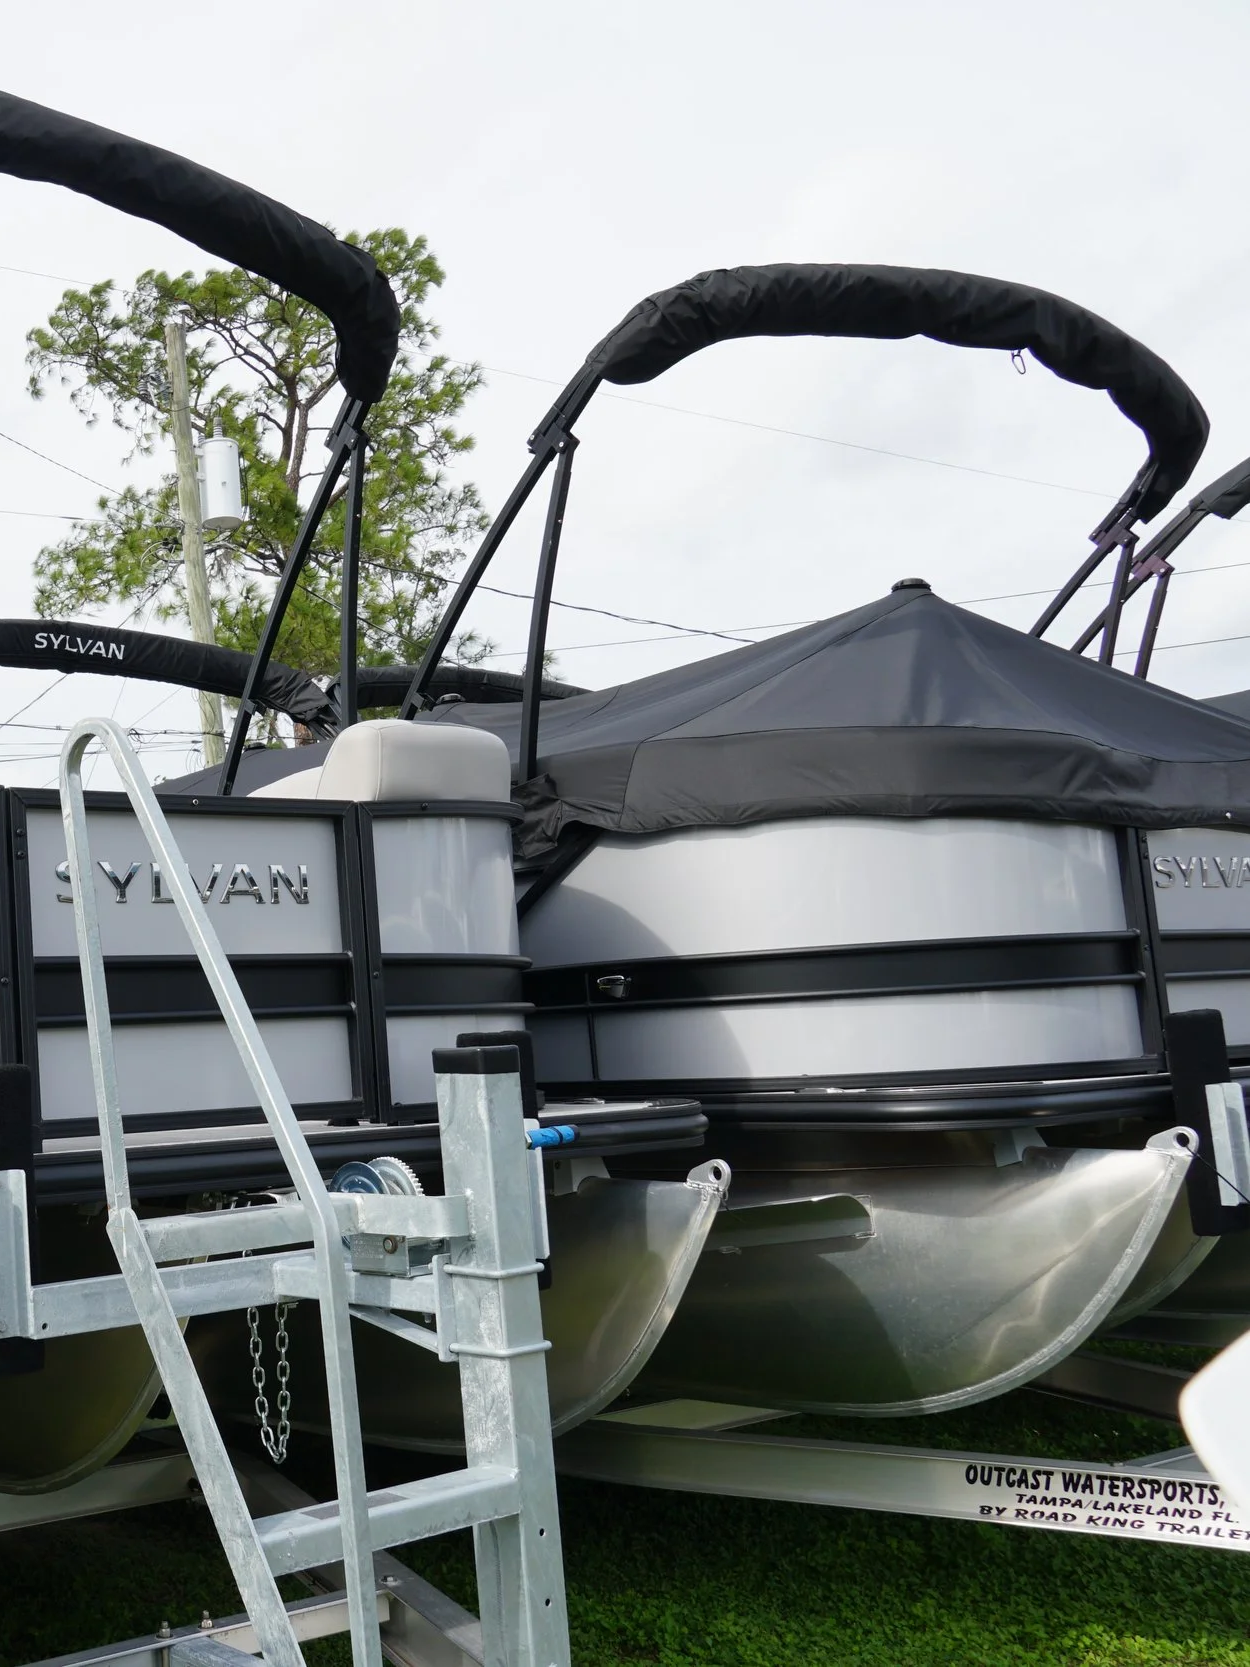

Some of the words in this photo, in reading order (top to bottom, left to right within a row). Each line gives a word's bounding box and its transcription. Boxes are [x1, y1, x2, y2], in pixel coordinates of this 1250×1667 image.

[34, 632, 125, 660] SYLVAN
[965, 1464, 1054, 1491] OUTCAST
[1062, 1472, 1225, 1509] WATERSPORTS,
[979, 1505, 1007, 1516] BY
[1015, 1509, 1077, 1522] ROAD
[1086, 1515, 1145, 1529] KING
[1016, 1494, 1202, 1519] TAMPA/LAKELAND
[1212, 1511, 1240, 1523] FL.
